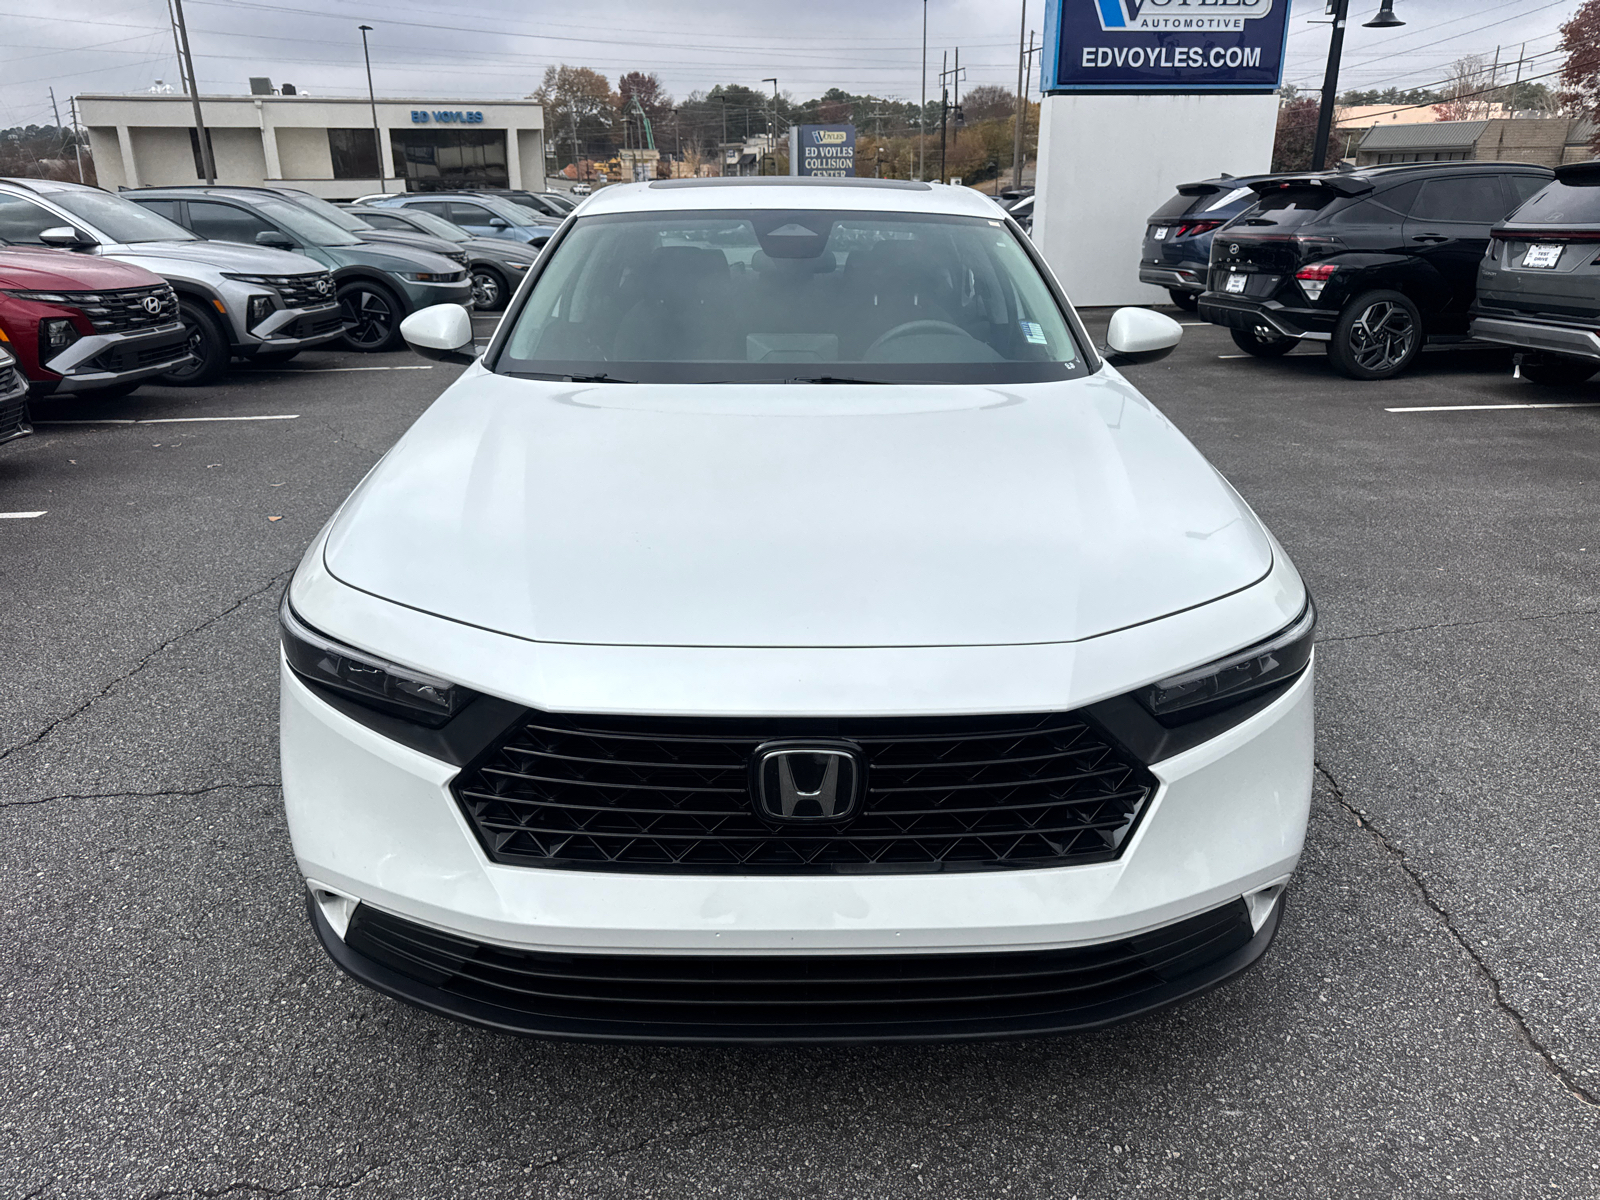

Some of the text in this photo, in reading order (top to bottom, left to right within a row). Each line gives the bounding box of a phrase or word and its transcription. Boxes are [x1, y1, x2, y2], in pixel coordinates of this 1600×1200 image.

[1140, 18, 1242, 28] AUTOMOTIVE
[1082, 47, 1262, 68] EDVOYLES.COM
[410, 110, 484, 123] ED VOYLES
[805, 147, 853, 157] ED VOYLES
[805, 158, 853, 169] COLLISION
